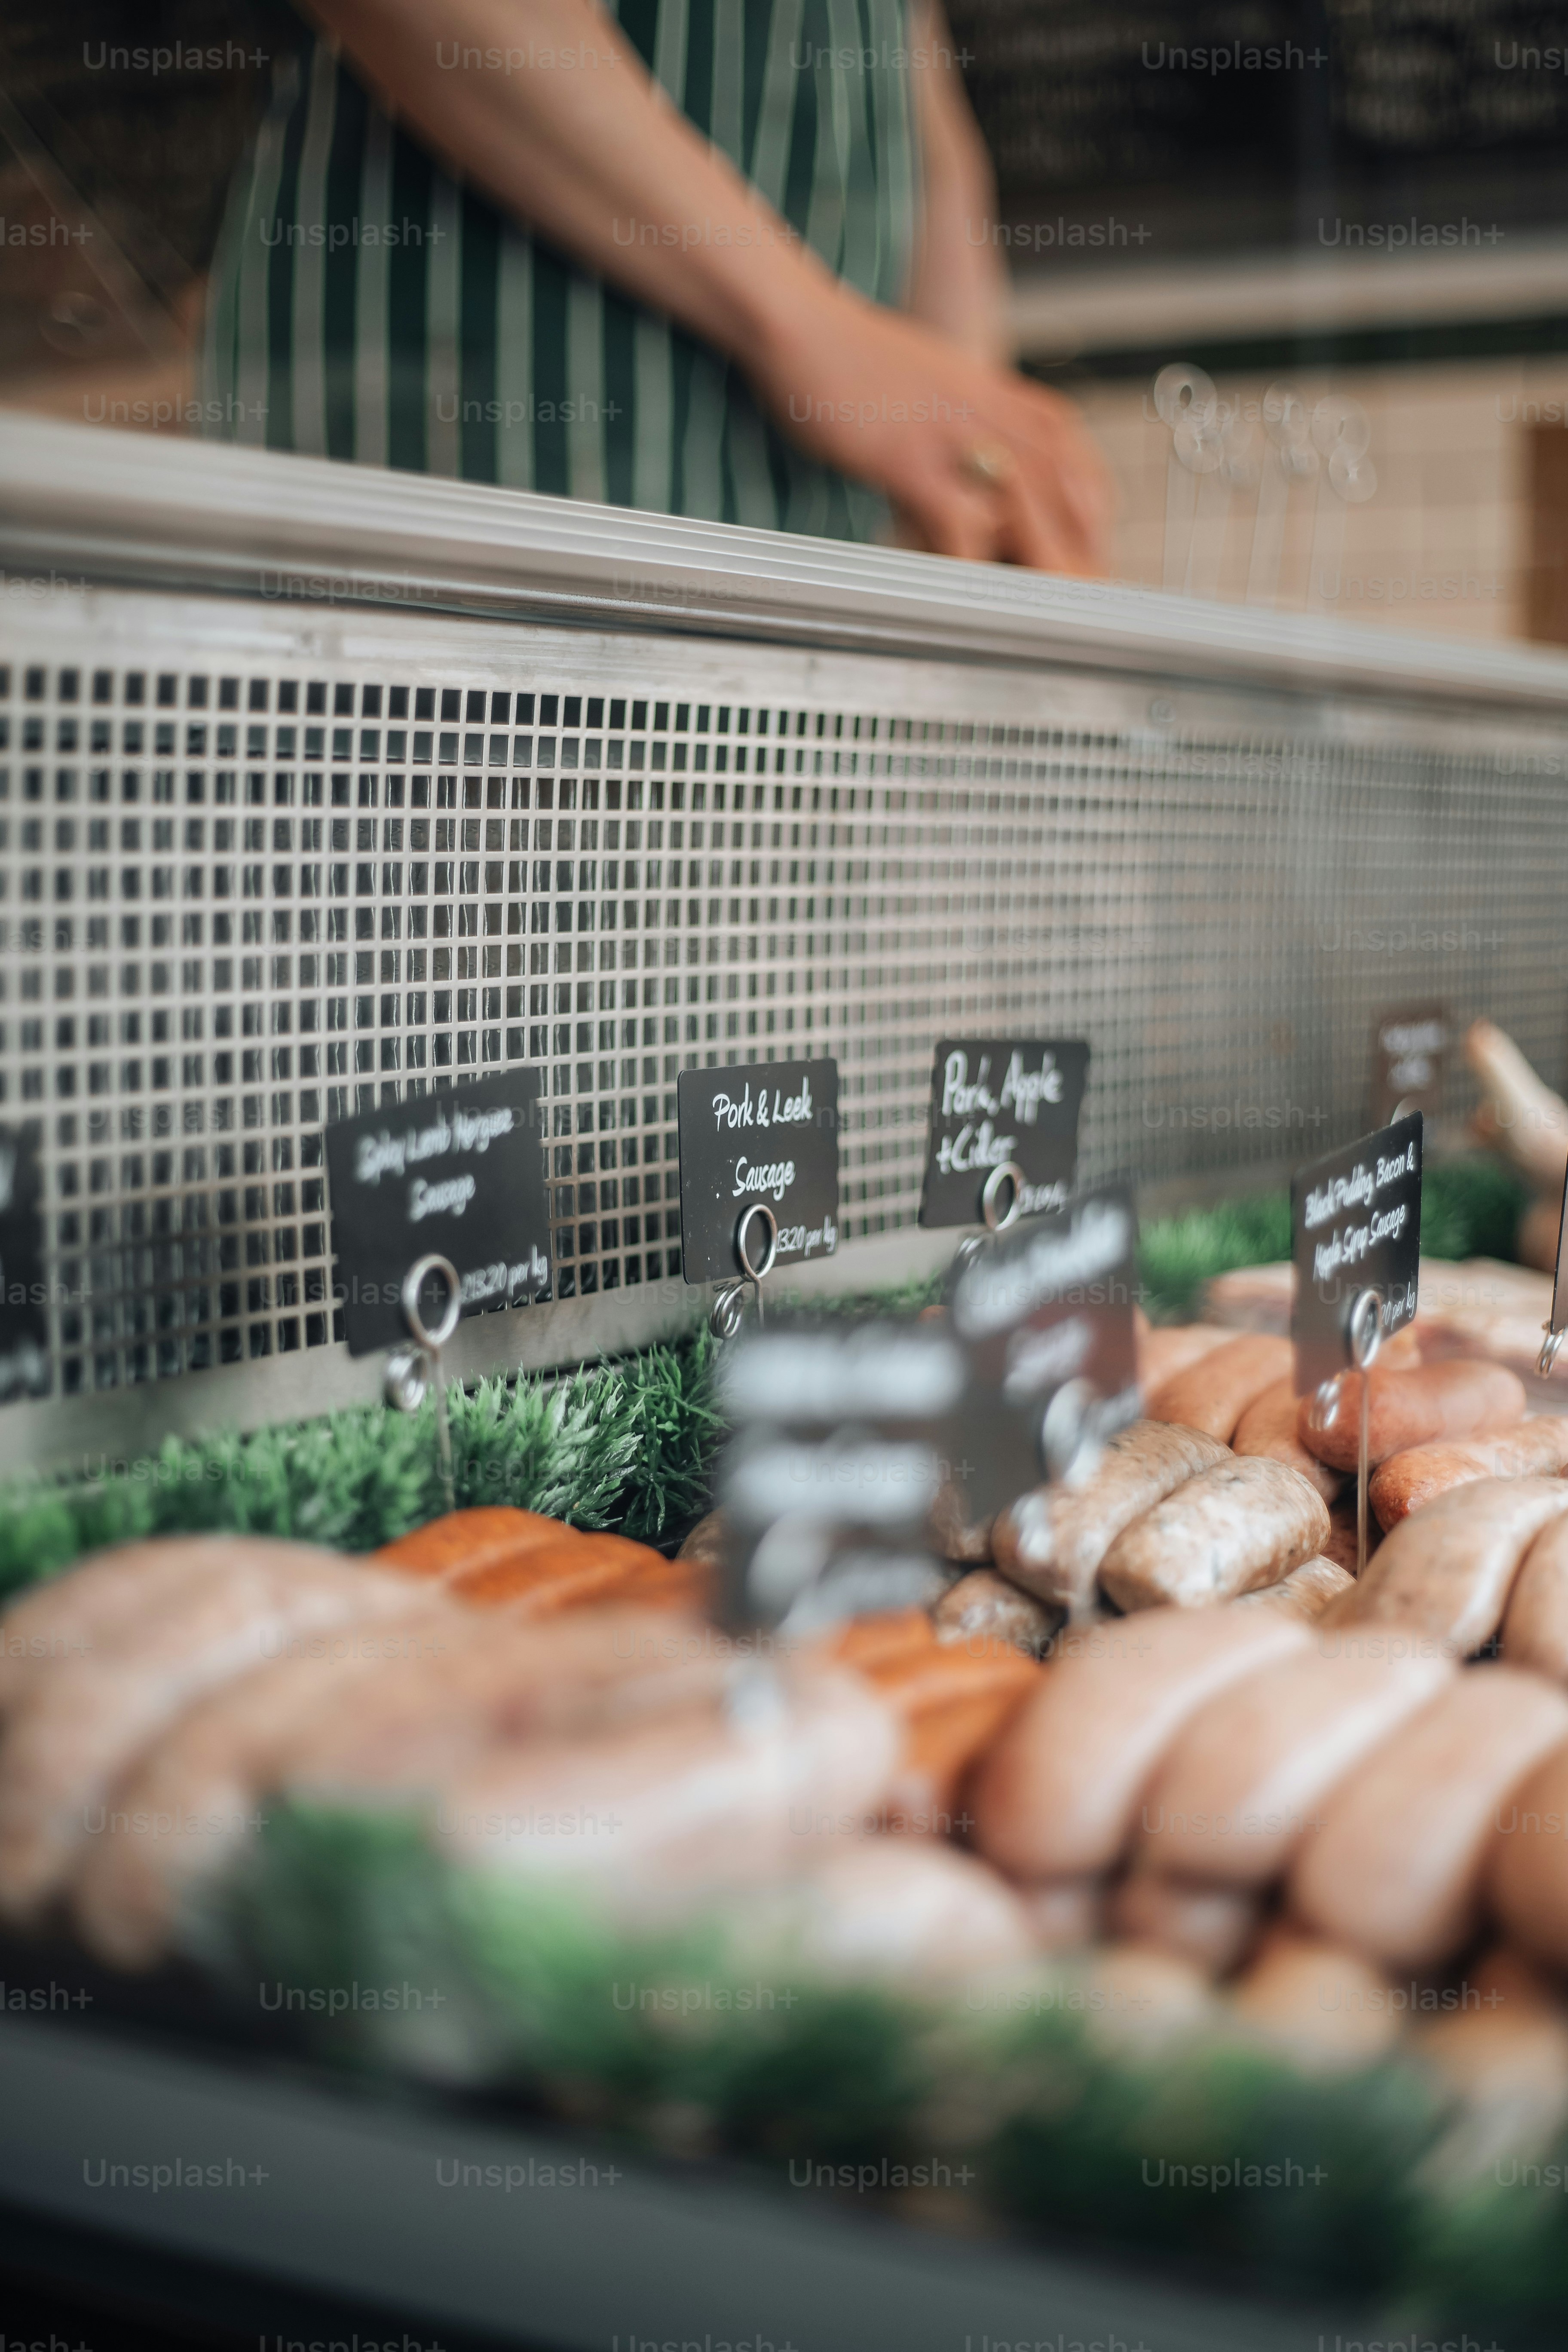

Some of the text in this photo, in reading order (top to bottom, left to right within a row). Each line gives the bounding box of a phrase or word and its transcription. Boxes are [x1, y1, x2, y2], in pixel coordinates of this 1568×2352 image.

[713, 1076, 812, 1132] Pork & Leek
[732, 1156, 796, 1201] Sausage
[1376, 1155, 1405, 1188] Bacon
[1407, 1141, 1413, 1170] &
[804, 1228, 823, 1258] per
[823, 1214, 838, 1255] kg
[1369, 1204, 1405, 1246] Sausage
[508, 1262, 530, 1297] per
[532, 1244, 548, 1286] kg
[1391, 1297, 1405, 1331] per
[1406, 1281, 1415, 1318] kg
